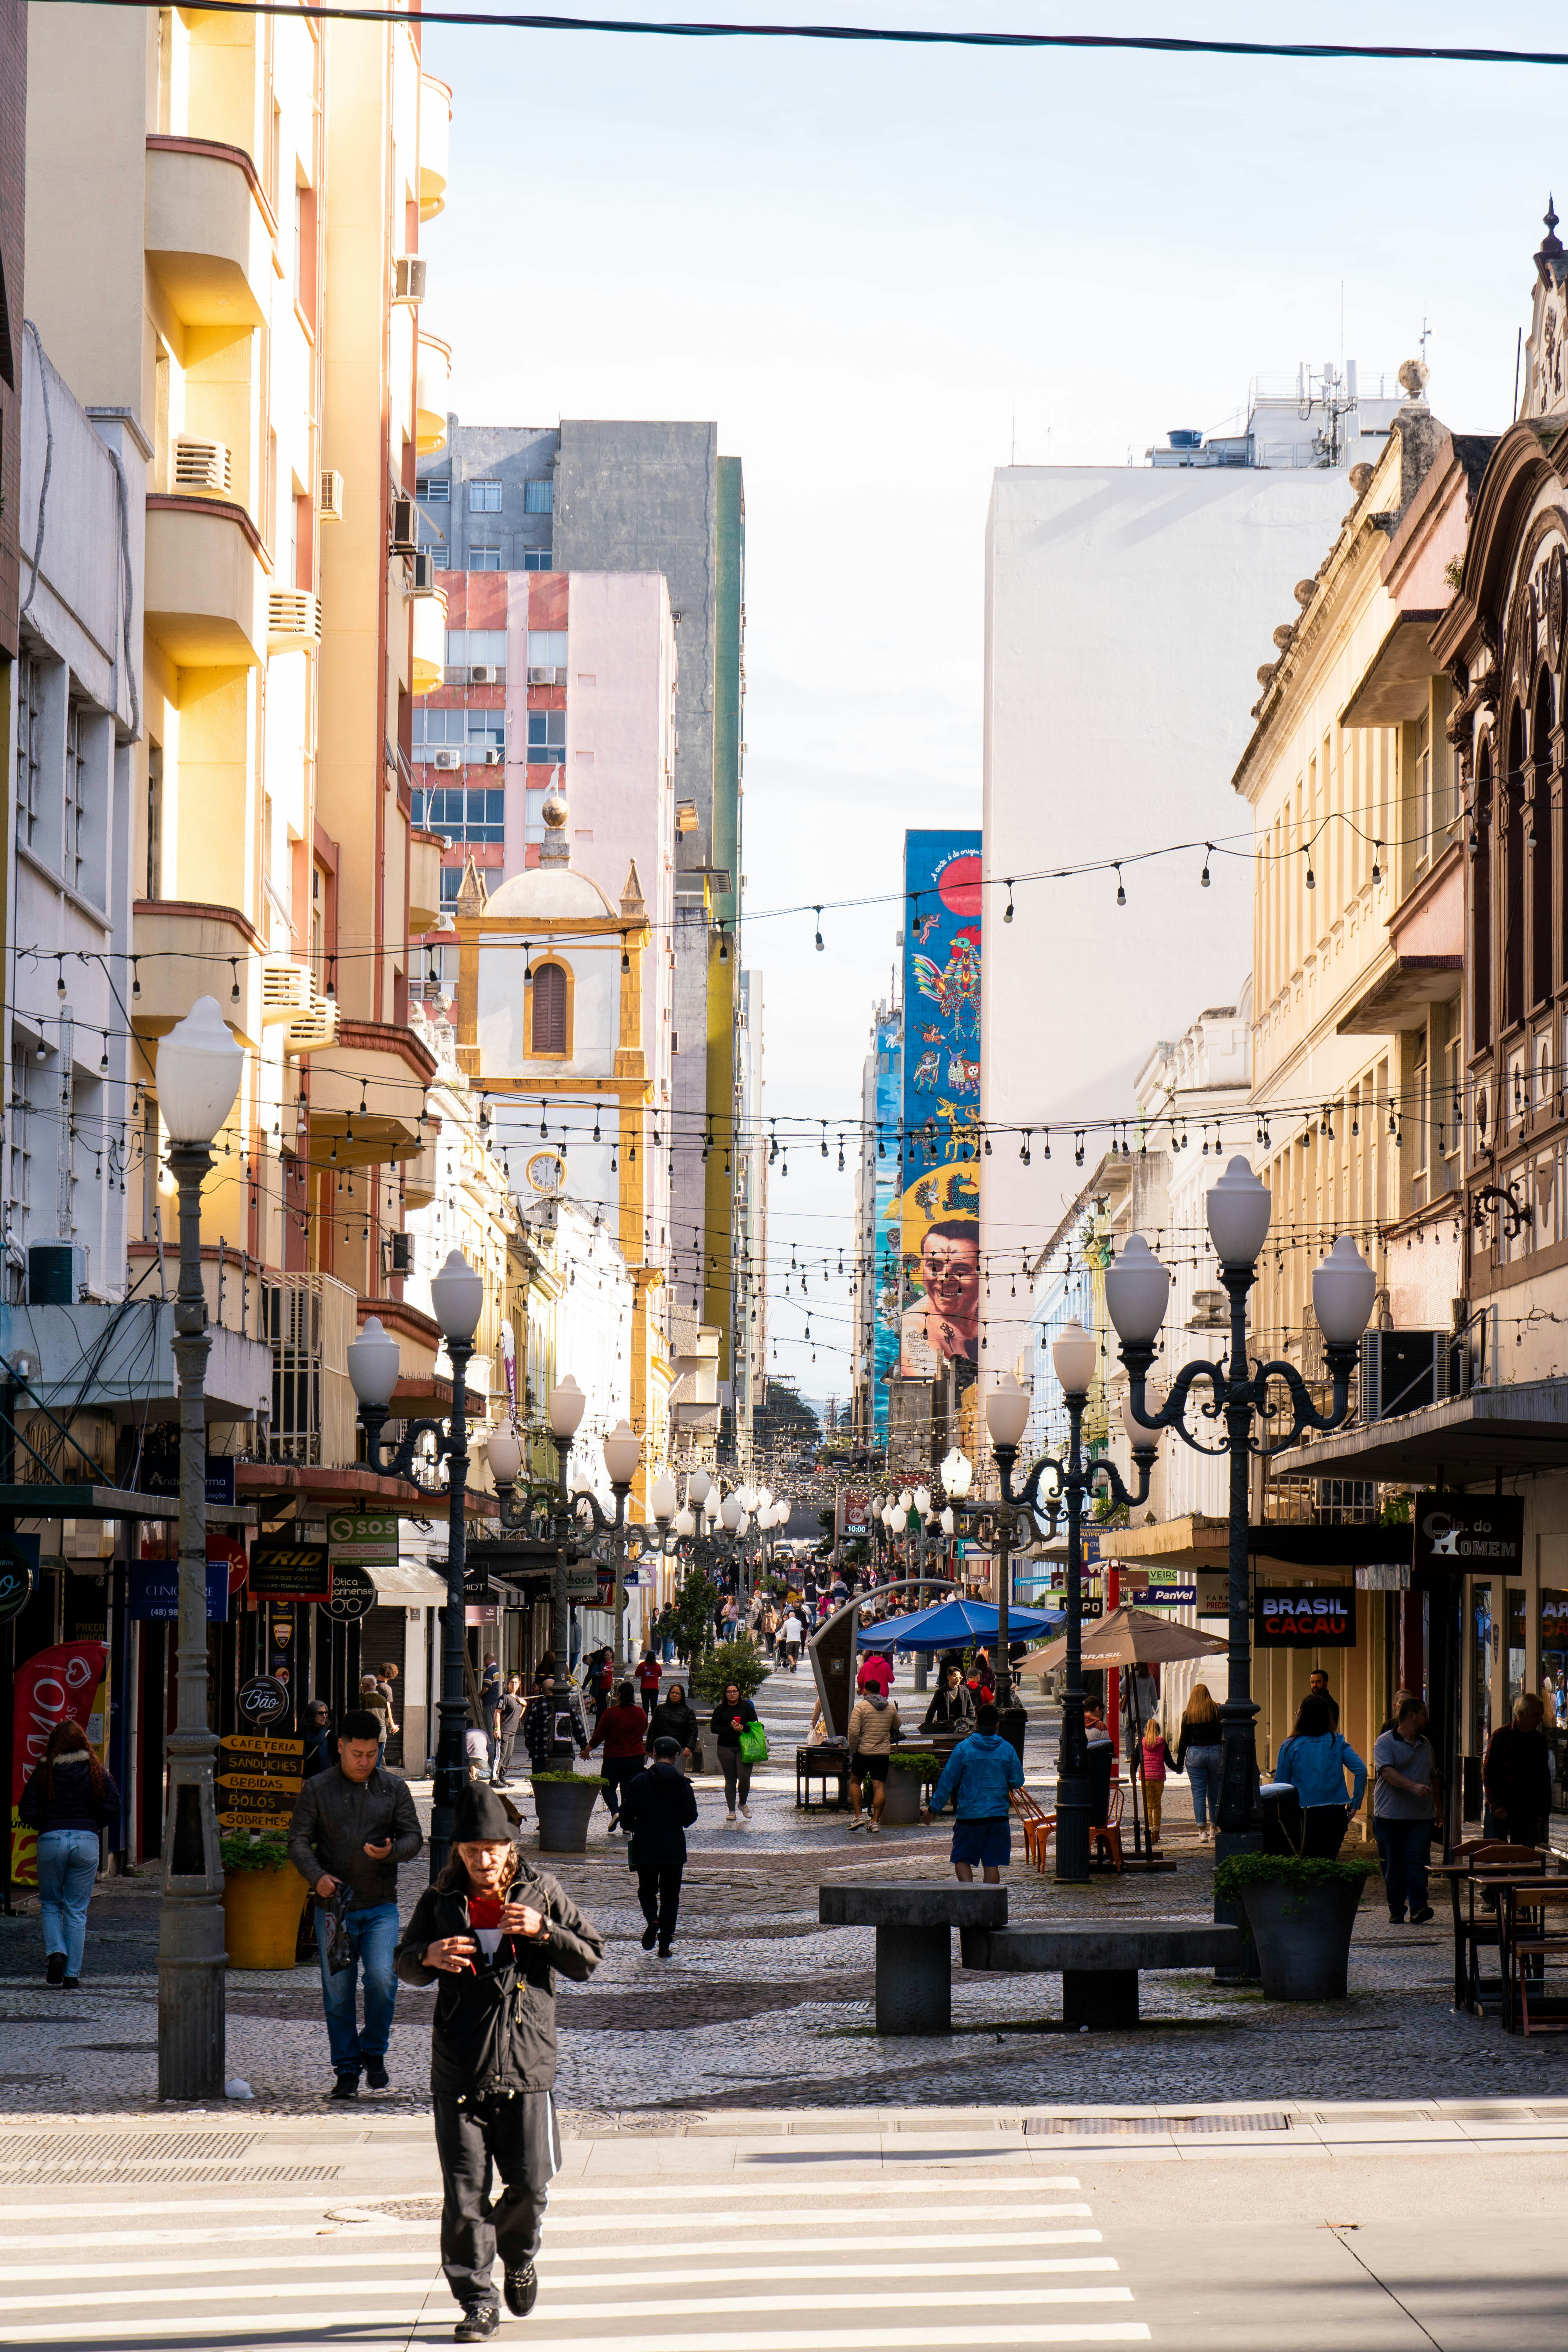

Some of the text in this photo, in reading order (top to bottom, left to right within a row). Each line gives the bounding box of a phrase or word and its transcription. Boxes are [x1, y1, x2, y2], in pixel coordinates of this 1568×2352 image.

[931, 873, 937, 882] A
[356, 1521, 395, 1534] S.O.S
[1474, 1519, 1492, 1532] do
[1430, 1531, 1516, 1557] HOMEM
[256, 1550, 323, 1566] TRID
[333, 1577, 358, 1586] Ótica
[332, 1587, 373, 1595] tarinense
[1155, 1591, 1194, 1599] PanVel
[151, 1608, 166, 1617] (48)
[1263, 1598, 1348, 1615] BRASIL
[76, 1623, 105, 1633] PREÇO
[1265, 1617, 1346, 1634] CACAU
[240, 1689, 279, 1710] Bão
[231, 1739, 296, 1751] CAFETERIA
[229, 1757, 297, 1772] SANDUICHES
[230, 1776, 283, 1789] BEBIDAS
[229, 1794, 275, 1808] BOLOS
